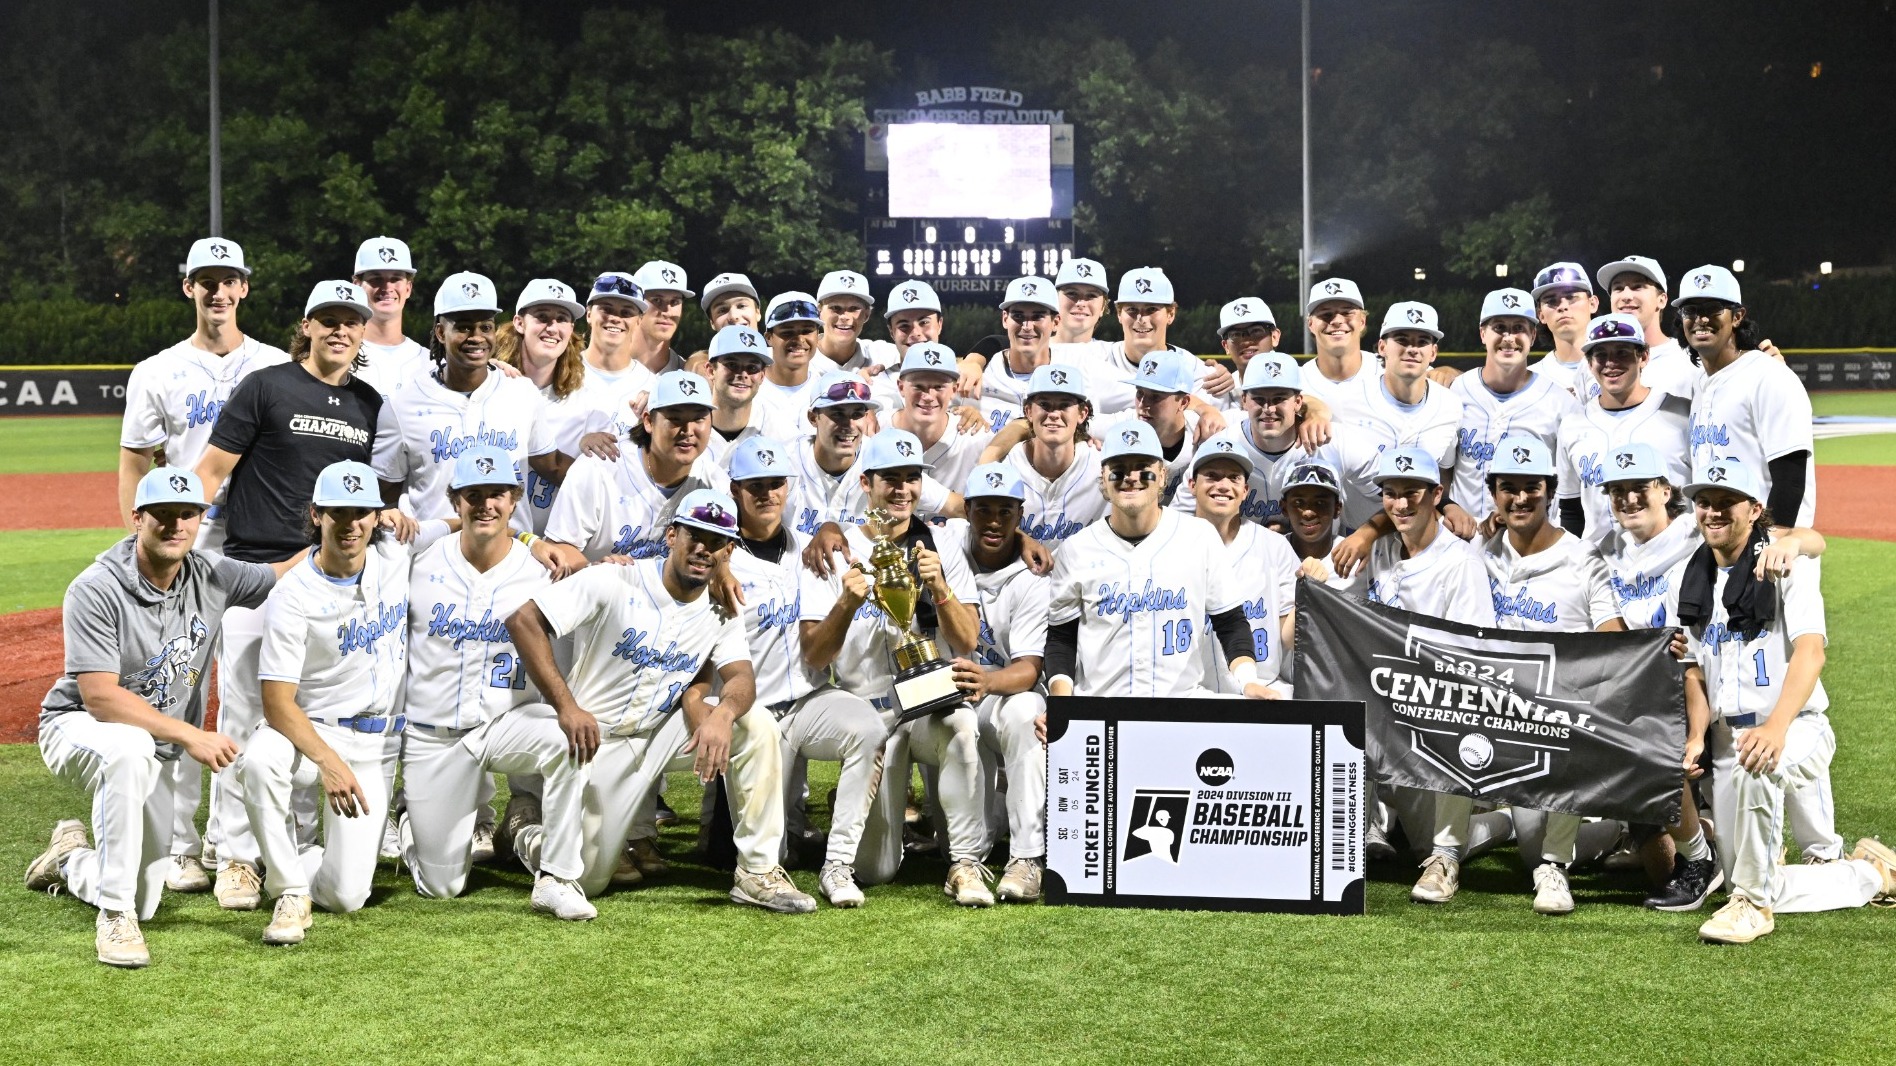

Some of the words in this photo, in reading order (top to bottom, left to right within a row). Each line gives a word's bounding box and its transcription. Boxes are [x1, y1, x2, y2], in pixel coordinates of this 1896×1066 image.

[915, 87, 967, 107] BABB
[970, 86, 1023, 107] FIELD
[873, 109, 979, 124] STROMBERG
[983, 109, 1065, 124] STADIUM
[932, 279, 990, 291] MURREN
[99, 384, 126, 398] TO
[1020, 513, 1094, 543] Hopkin
[1097, 579, 1188, 624] Hopkins
[428, 602, 513, 650] Hopkin
[1162, 618, 1193, 656] 18
[612, 627, 700, 674] Hopkins
[490, 652, 527, 690] 21
[1753, 649, 1769, 686] 1
[1370, 667, 1597, 732] CENTENNIAL
[1392, 702, 1480, 726] CONFERENCE
[1484, 716, 1570, 739] CHAMPIONS
[1059, 768, 1069, 784] SEAT
[1072, 771, 1080, 782] 24
[1086, 734, 1100, 815] PUNCHED
[1200, 766, 1233, 777] NCAA
[1059, 796, 1068, 812] ROW
[1071, 800, 1079, 811] 05
[1197, 790, 1224, 800] 2024
[1226, 791, 1274, 801] DIVISION
[1276, 792, 1292, 802] III
[1193, 803, 1304, 828] BASEBALL
[1349, 762, 1357, 872] #IGNITINGGREATNESS
[1059, 827, 1068, 840] SEC
[1071, 828, 1079, 840] 05
[1190, 828, 1308, 847] CHAMPIONSHIP
[1085, 820, 1099, 878] TICKET
